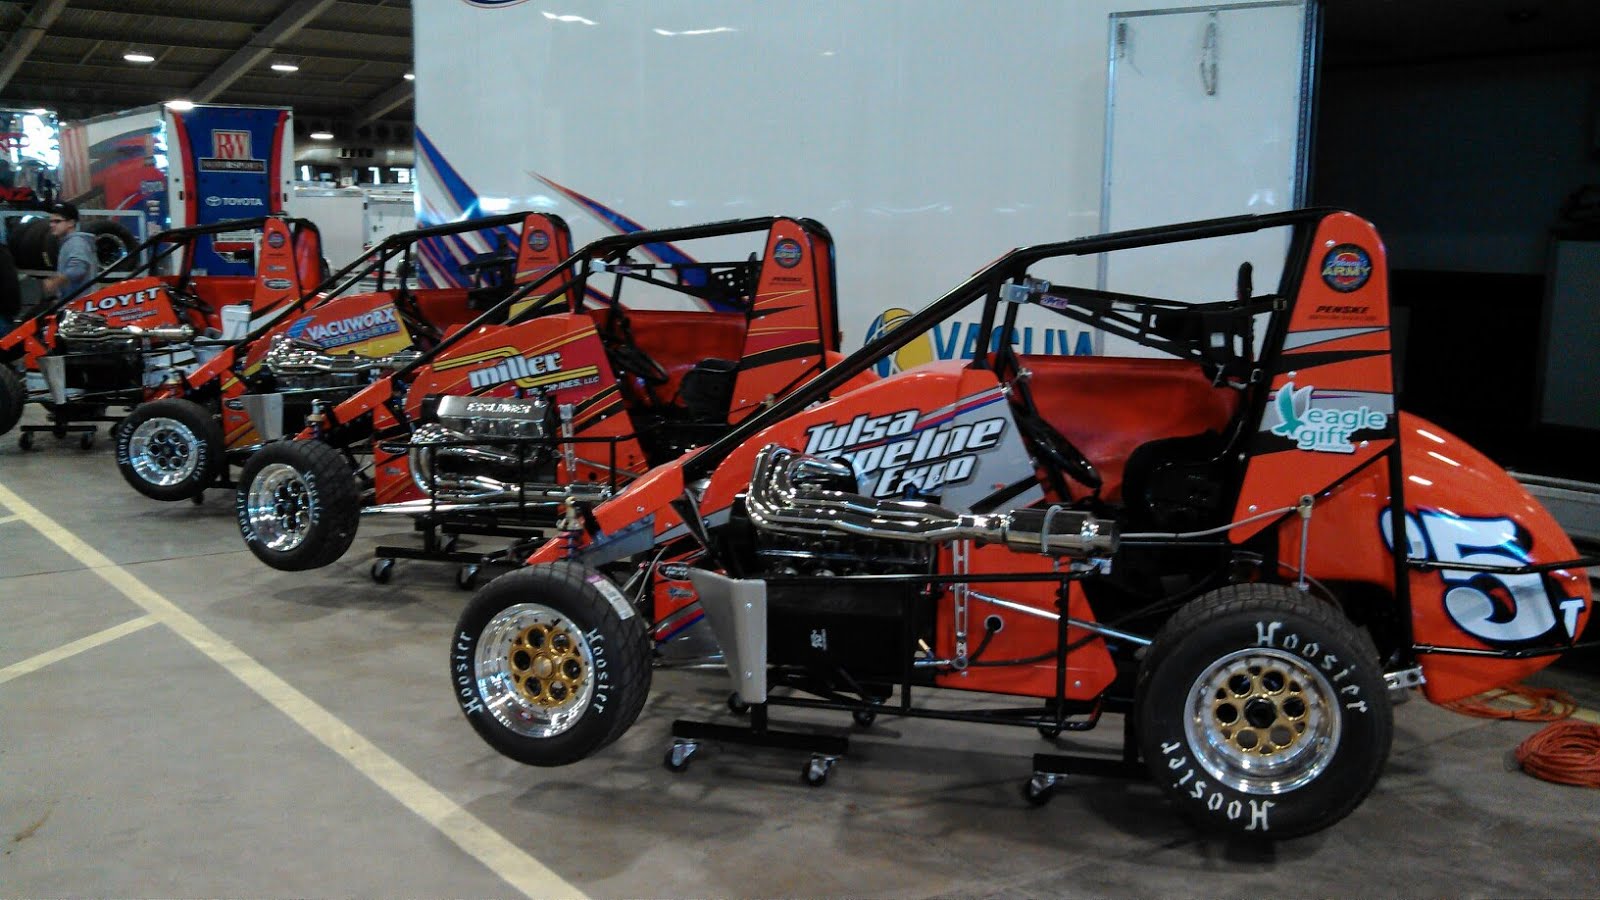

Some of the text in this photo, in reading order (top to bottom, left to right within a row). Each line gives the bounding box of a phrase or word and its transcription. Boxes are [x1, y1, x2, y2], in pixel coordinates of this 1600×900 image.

[222, 197, 264, 206] TOYOTA
[1322, 266, 1372, 276] ARMY
[85, 287, 160, 312] LOYET
[1316, 305, 1370, 314] PENSKE
[307, 308, 396, 341] VACUWORX
[467, 351, 562, 389] miller
[806, 409, 920, 454] Tulsa
[1300, 425, 1348, 447] gift
[1308, 407, 1386, 430] eagle
[816, 418, 1006, 476] peline
[874, 453, 978, 498] Expo
[456, 631, 484, 716] Hoosier
[585, 627, 616, 715] Hoosier
[1256, 621, 1368, 714] Hoosier
[1160, 741, 1276, 831] Hoosier
